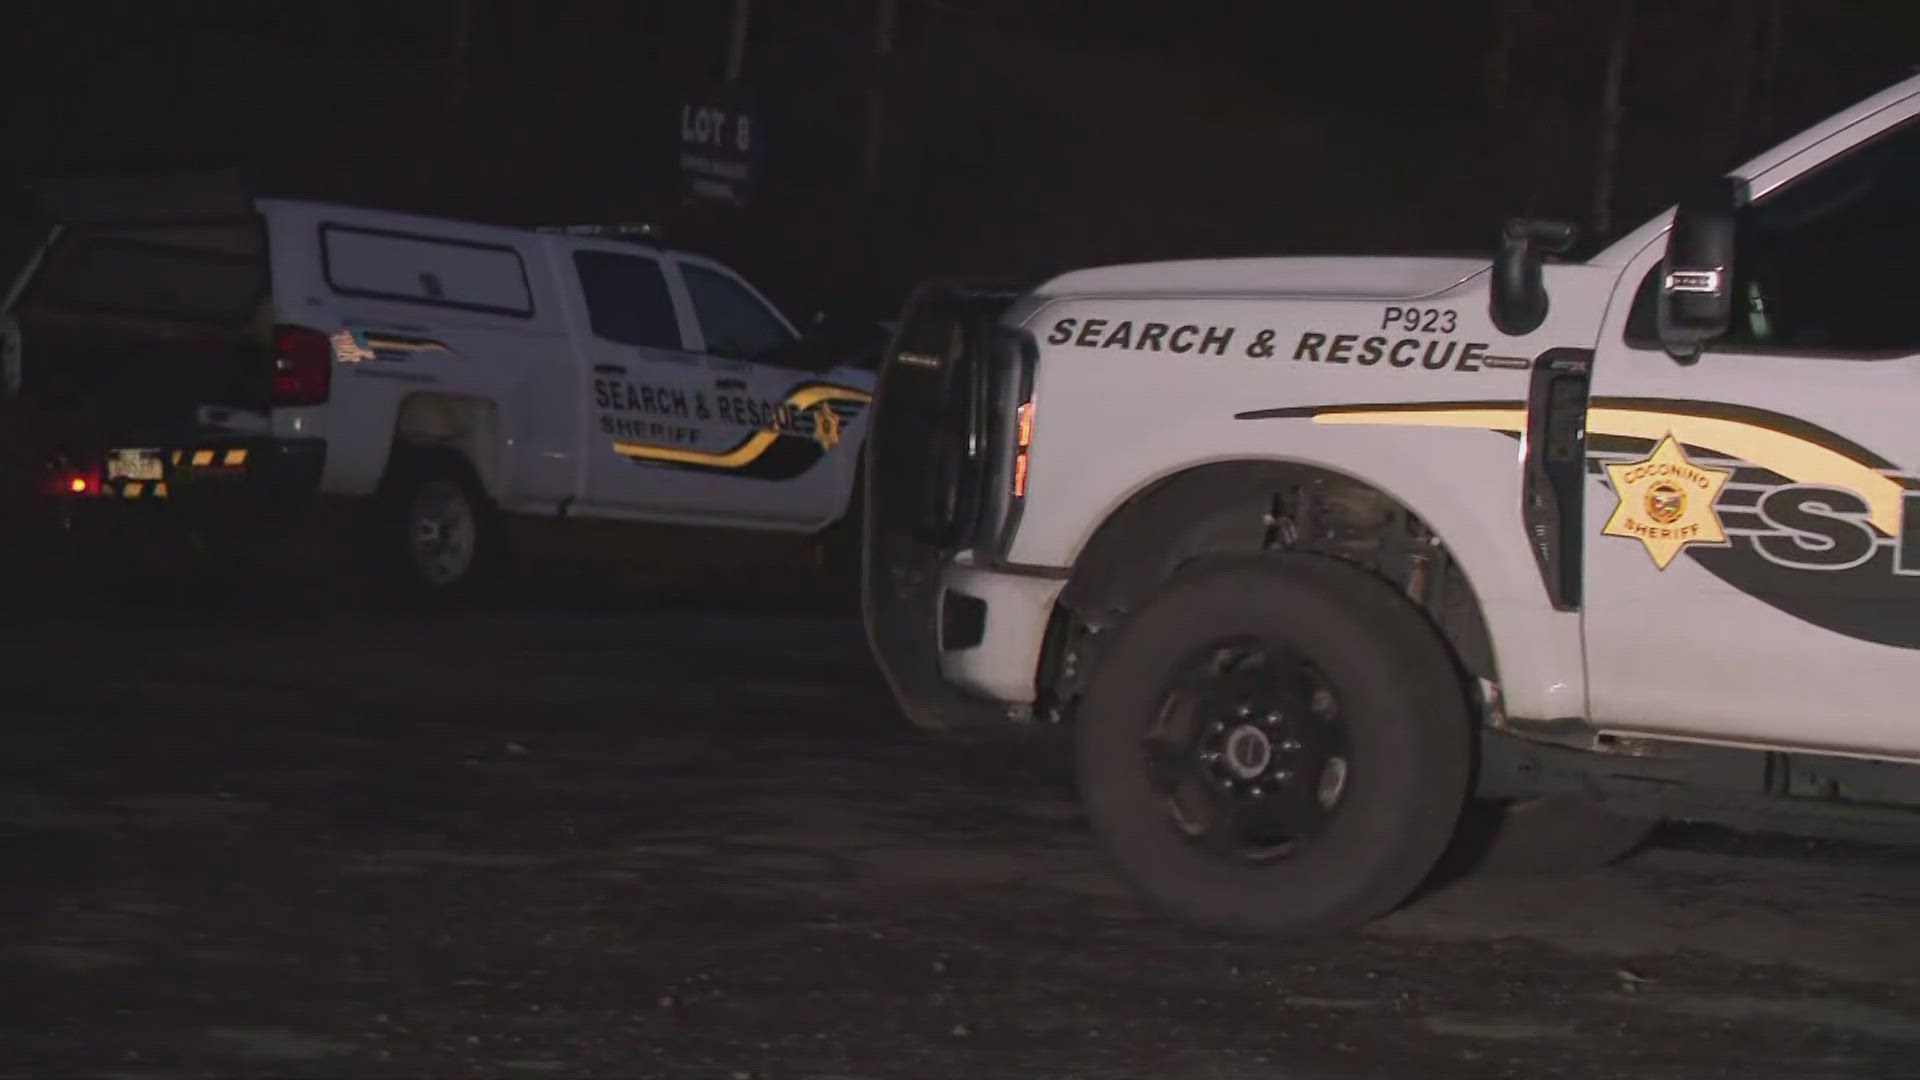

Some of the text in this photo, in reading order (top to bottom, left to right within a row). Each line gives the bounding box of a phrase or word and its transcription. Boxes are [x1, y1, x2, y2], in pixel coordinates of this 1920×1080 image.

[681, 104, 750, 151] LOT 8
[1381, 307, 1457, 334] P923
[1047, 318, 1489, 372] SEARCH & RESCUE
[595, 380, 801, 432] SEARCH & RESCUE
[601, 416, 701, 443] SHERIFF
[1624, 463, 1709, 489] COCONINO
[1624, 519, 1699, 539] SHERIFF
